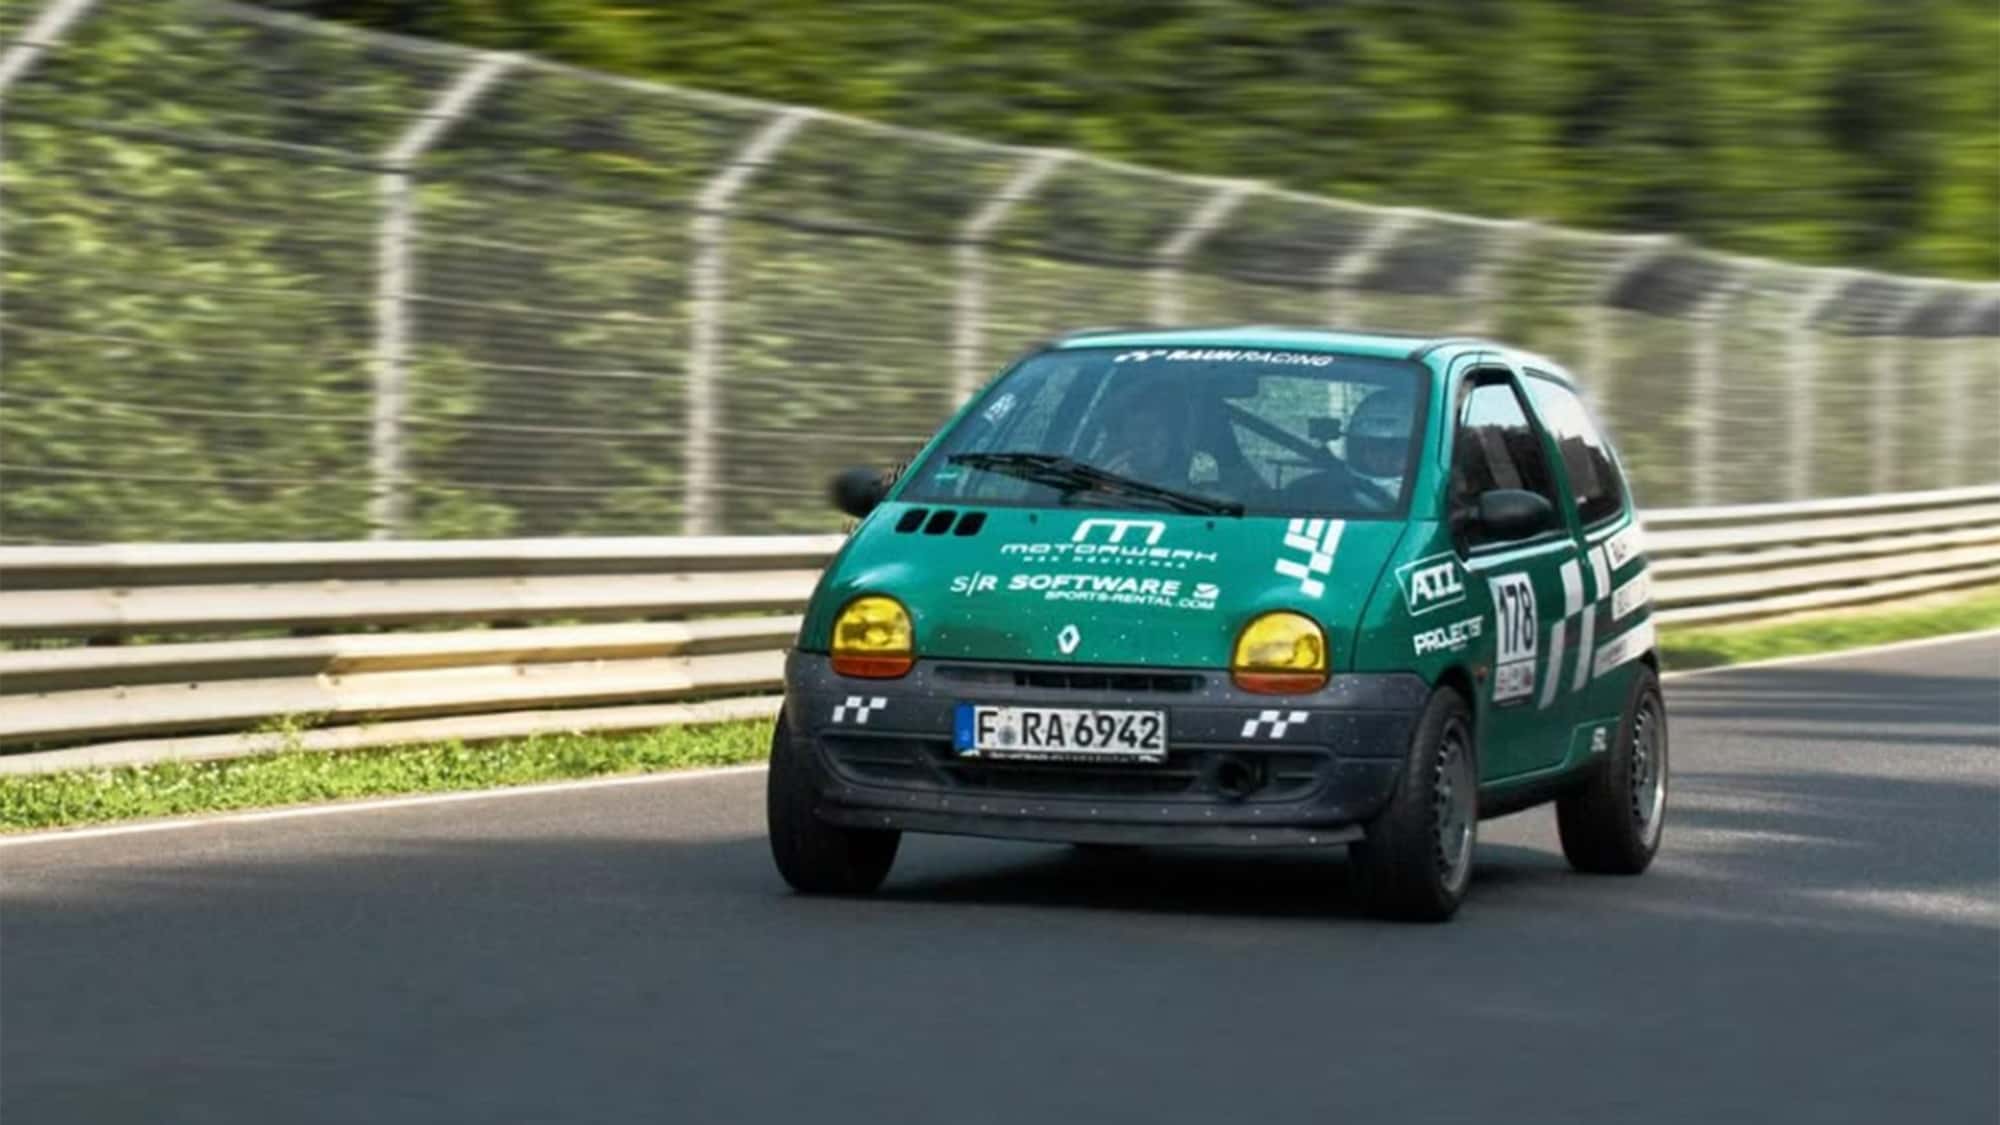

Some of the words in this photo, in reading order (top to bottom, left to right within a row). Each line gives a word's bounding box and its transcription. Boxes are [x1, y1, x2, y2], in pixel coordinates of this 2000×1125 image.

[1001, 543, 1218, 562] MOTORWERK
[1007, 574, 1181, 597] SOFTWARE
[1497, 580, 1534, 655] 178
[977, 711, 998, 743] F
[1022, 712, 1065, 747] RA
[1074, 714, 1160, 749] 6942
